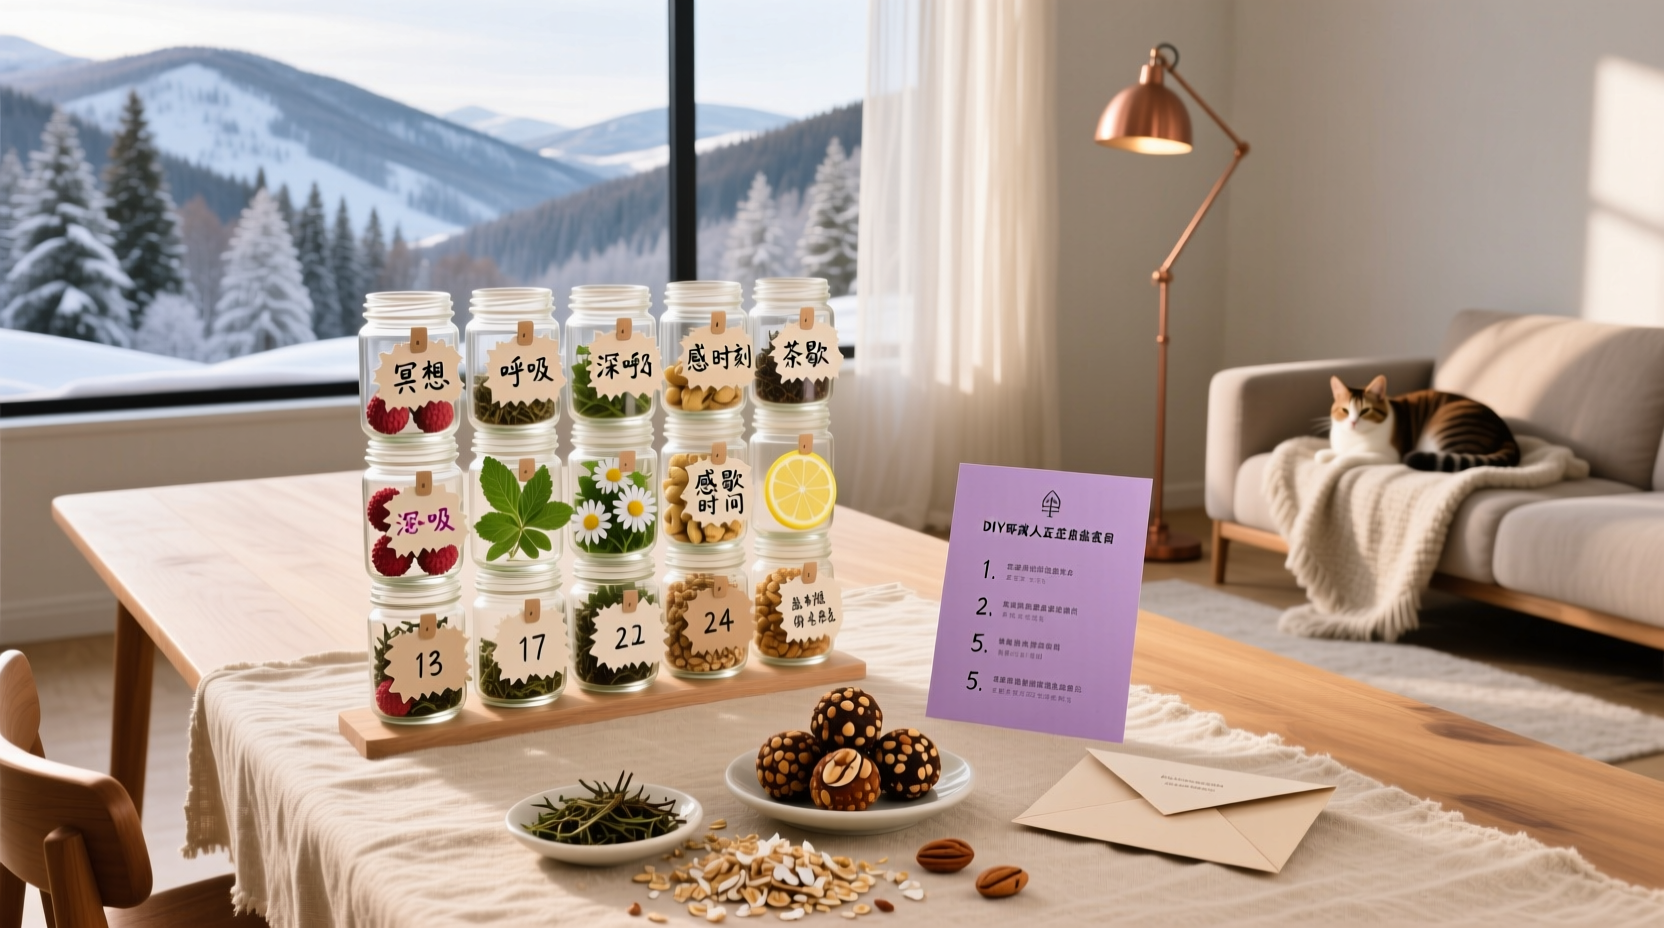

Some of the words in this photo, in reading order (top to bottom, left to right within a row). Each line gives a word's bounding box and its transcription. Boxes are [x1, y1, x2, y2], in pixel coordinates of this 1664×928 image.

[687, 343, 752, 373] 感时刻
[782, 339, 830, 369] 茶歇
[393, 359, 450, 394] 冥想
[500, 355, 555, 387] 呼吸
[983, 559, 996, 580] 1.
[704, 608, 735, 634] 24
[976, 597, 993, 617] 2.
[519, 633, 546, 663] 17
[970, 632, 988, 654] 5.
[415, 649, 443, 679] 13
[966, 670, 983, 692] 5.
